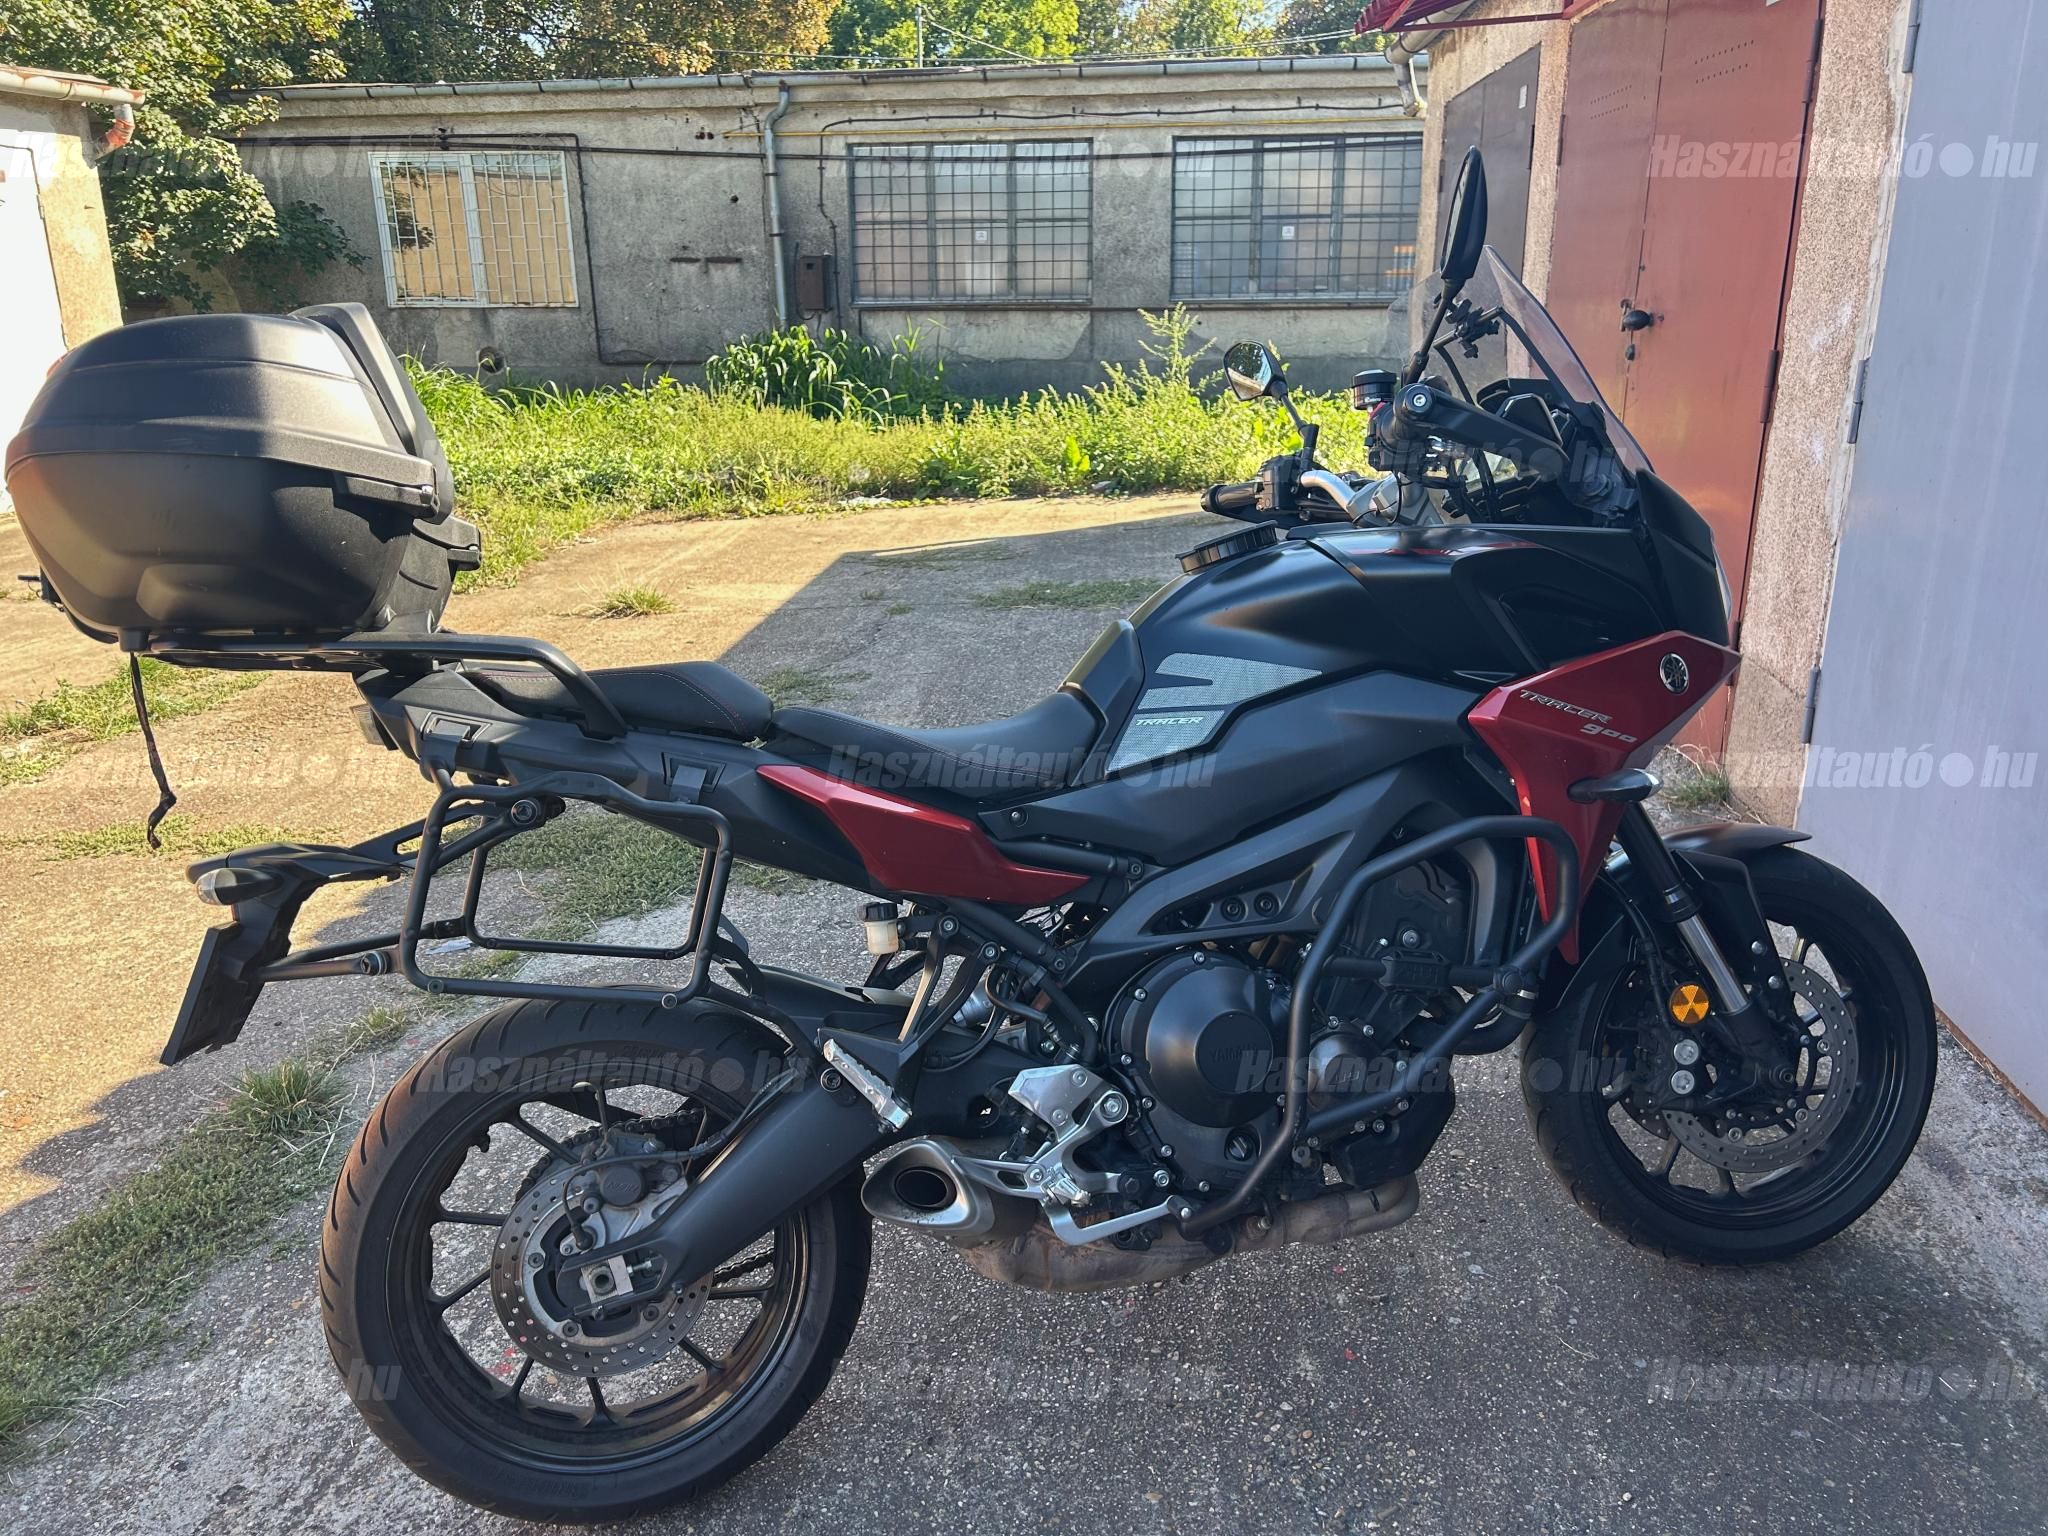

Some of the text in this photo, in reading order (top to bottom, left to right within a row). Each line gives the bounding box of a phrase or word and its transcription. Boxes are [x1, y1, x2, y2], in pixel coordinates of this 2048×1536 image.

[1520, 689, 1613, 724] TRACER
[1136, 717, 1204, 726] TRACER
[1580, 723, 1638, 743] 900
